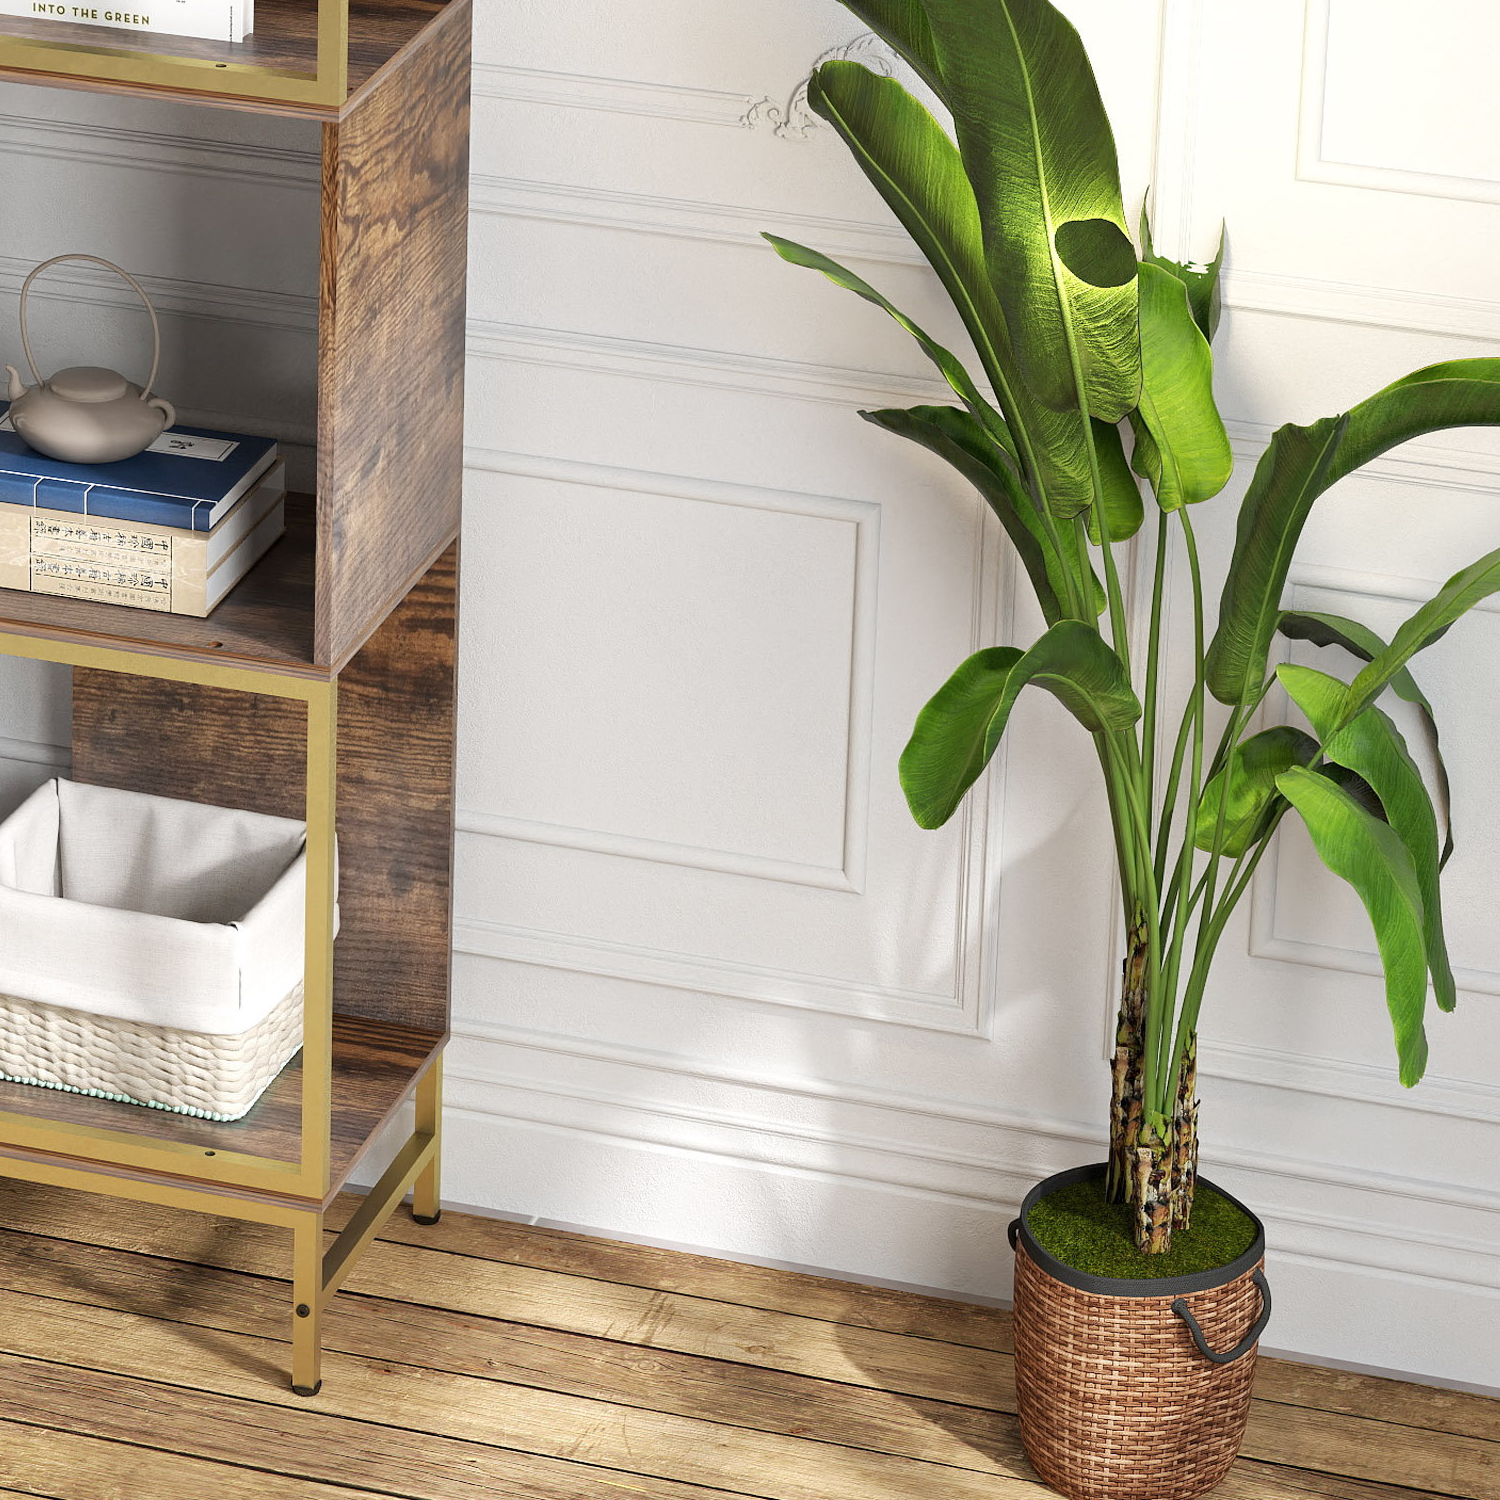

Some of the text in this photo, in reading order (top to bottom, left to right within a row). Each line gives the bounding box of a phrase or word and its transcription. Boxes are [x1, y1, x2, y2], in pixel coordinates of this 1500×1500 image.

[32, 2, 151, 25] INTO THE GREEN
